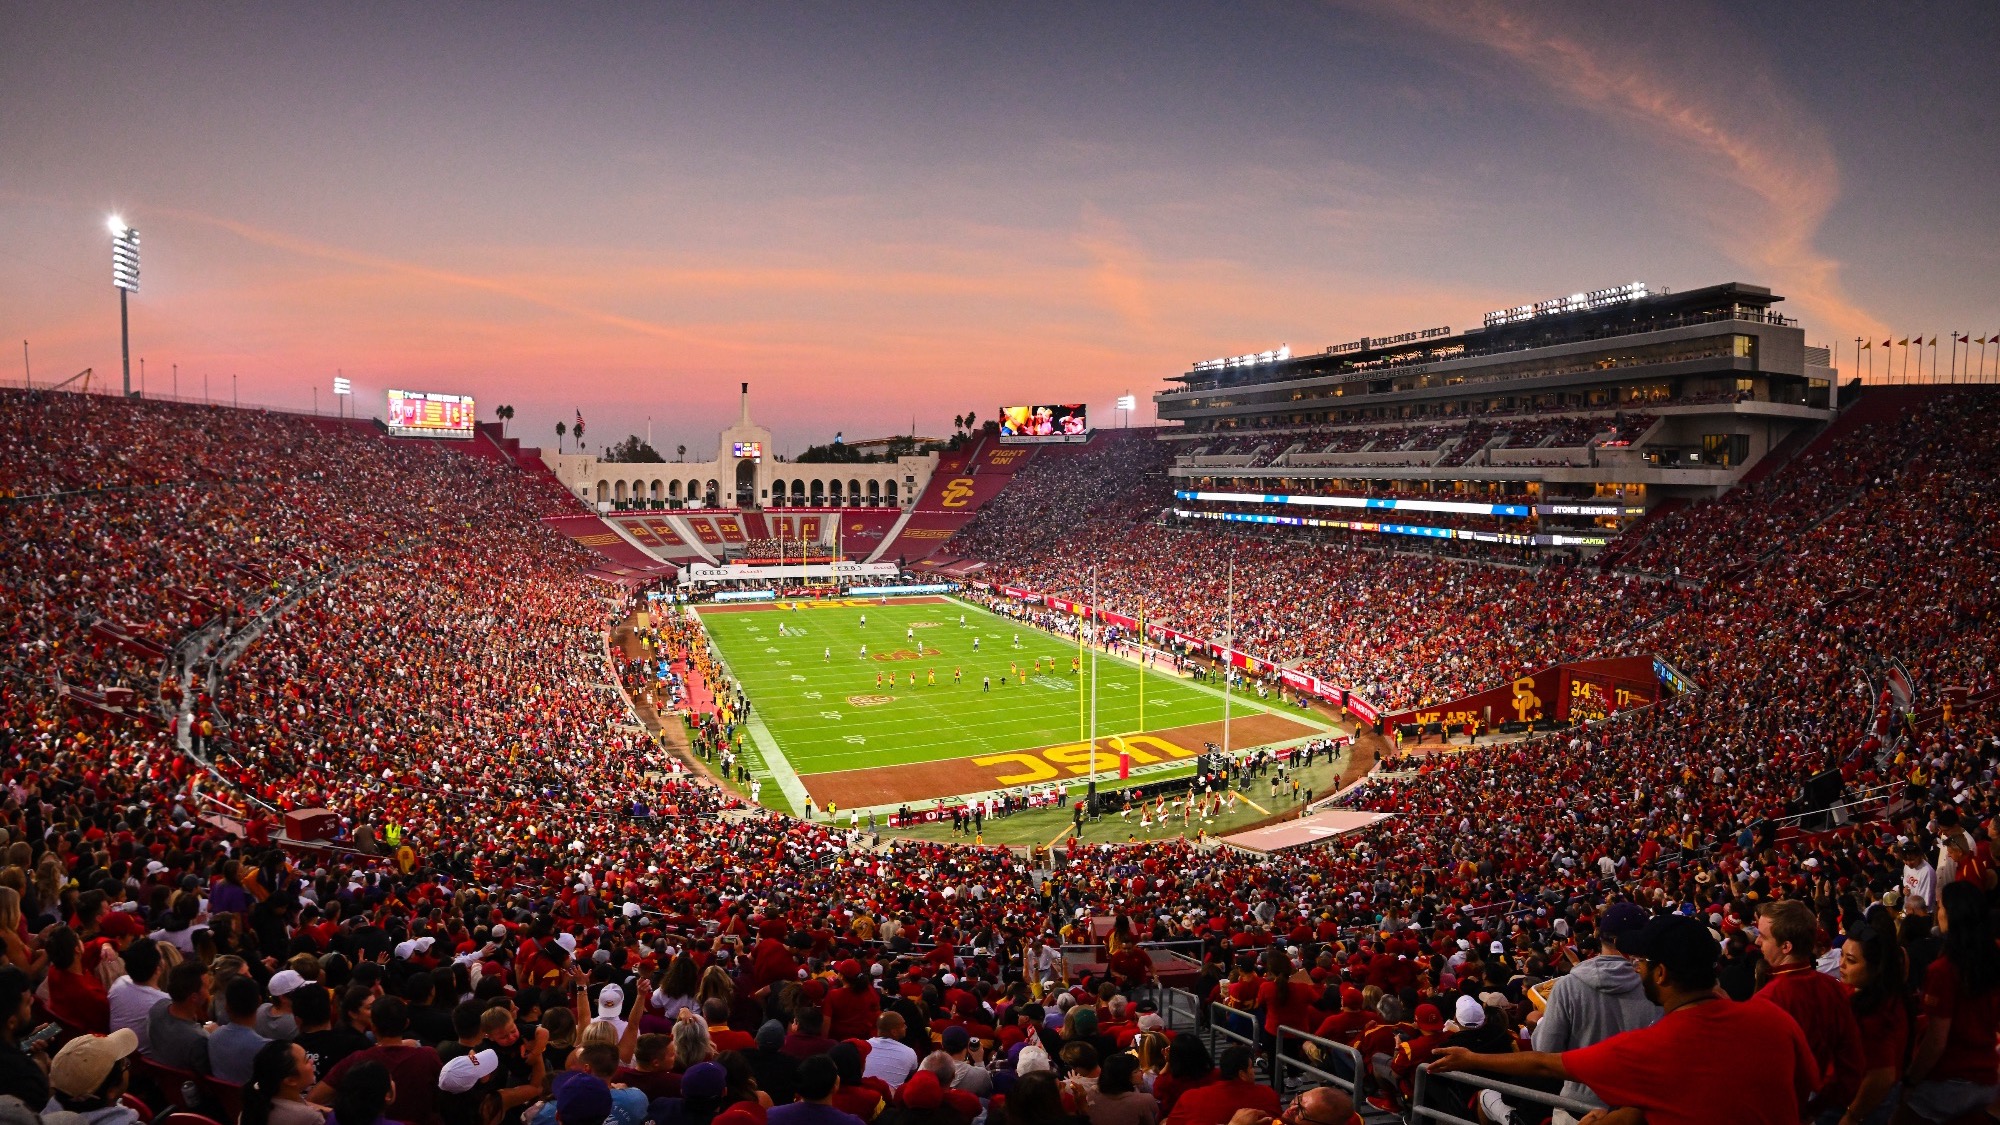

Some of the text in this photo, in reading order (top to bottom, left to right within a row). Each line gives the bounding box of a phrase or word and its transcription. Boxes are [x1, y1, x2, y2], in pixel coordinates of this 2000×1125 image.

[1326, 326, 1451, 354] UNITED AIRLINES FIELD
[1386, 368, 1408, 376] PRESS
[991, 457, 1013, 465] ON!
[1580, 506, 1618, 515] BREWING
[652, 526, 673, 535] 32
[696, 524, 712, 533] 12
[720, 524, 738, 532] 33
[774, 600, 877, 610] USC
[1571, 680, 1591, 699] 34
[972, 736, 1198, 786] USC
